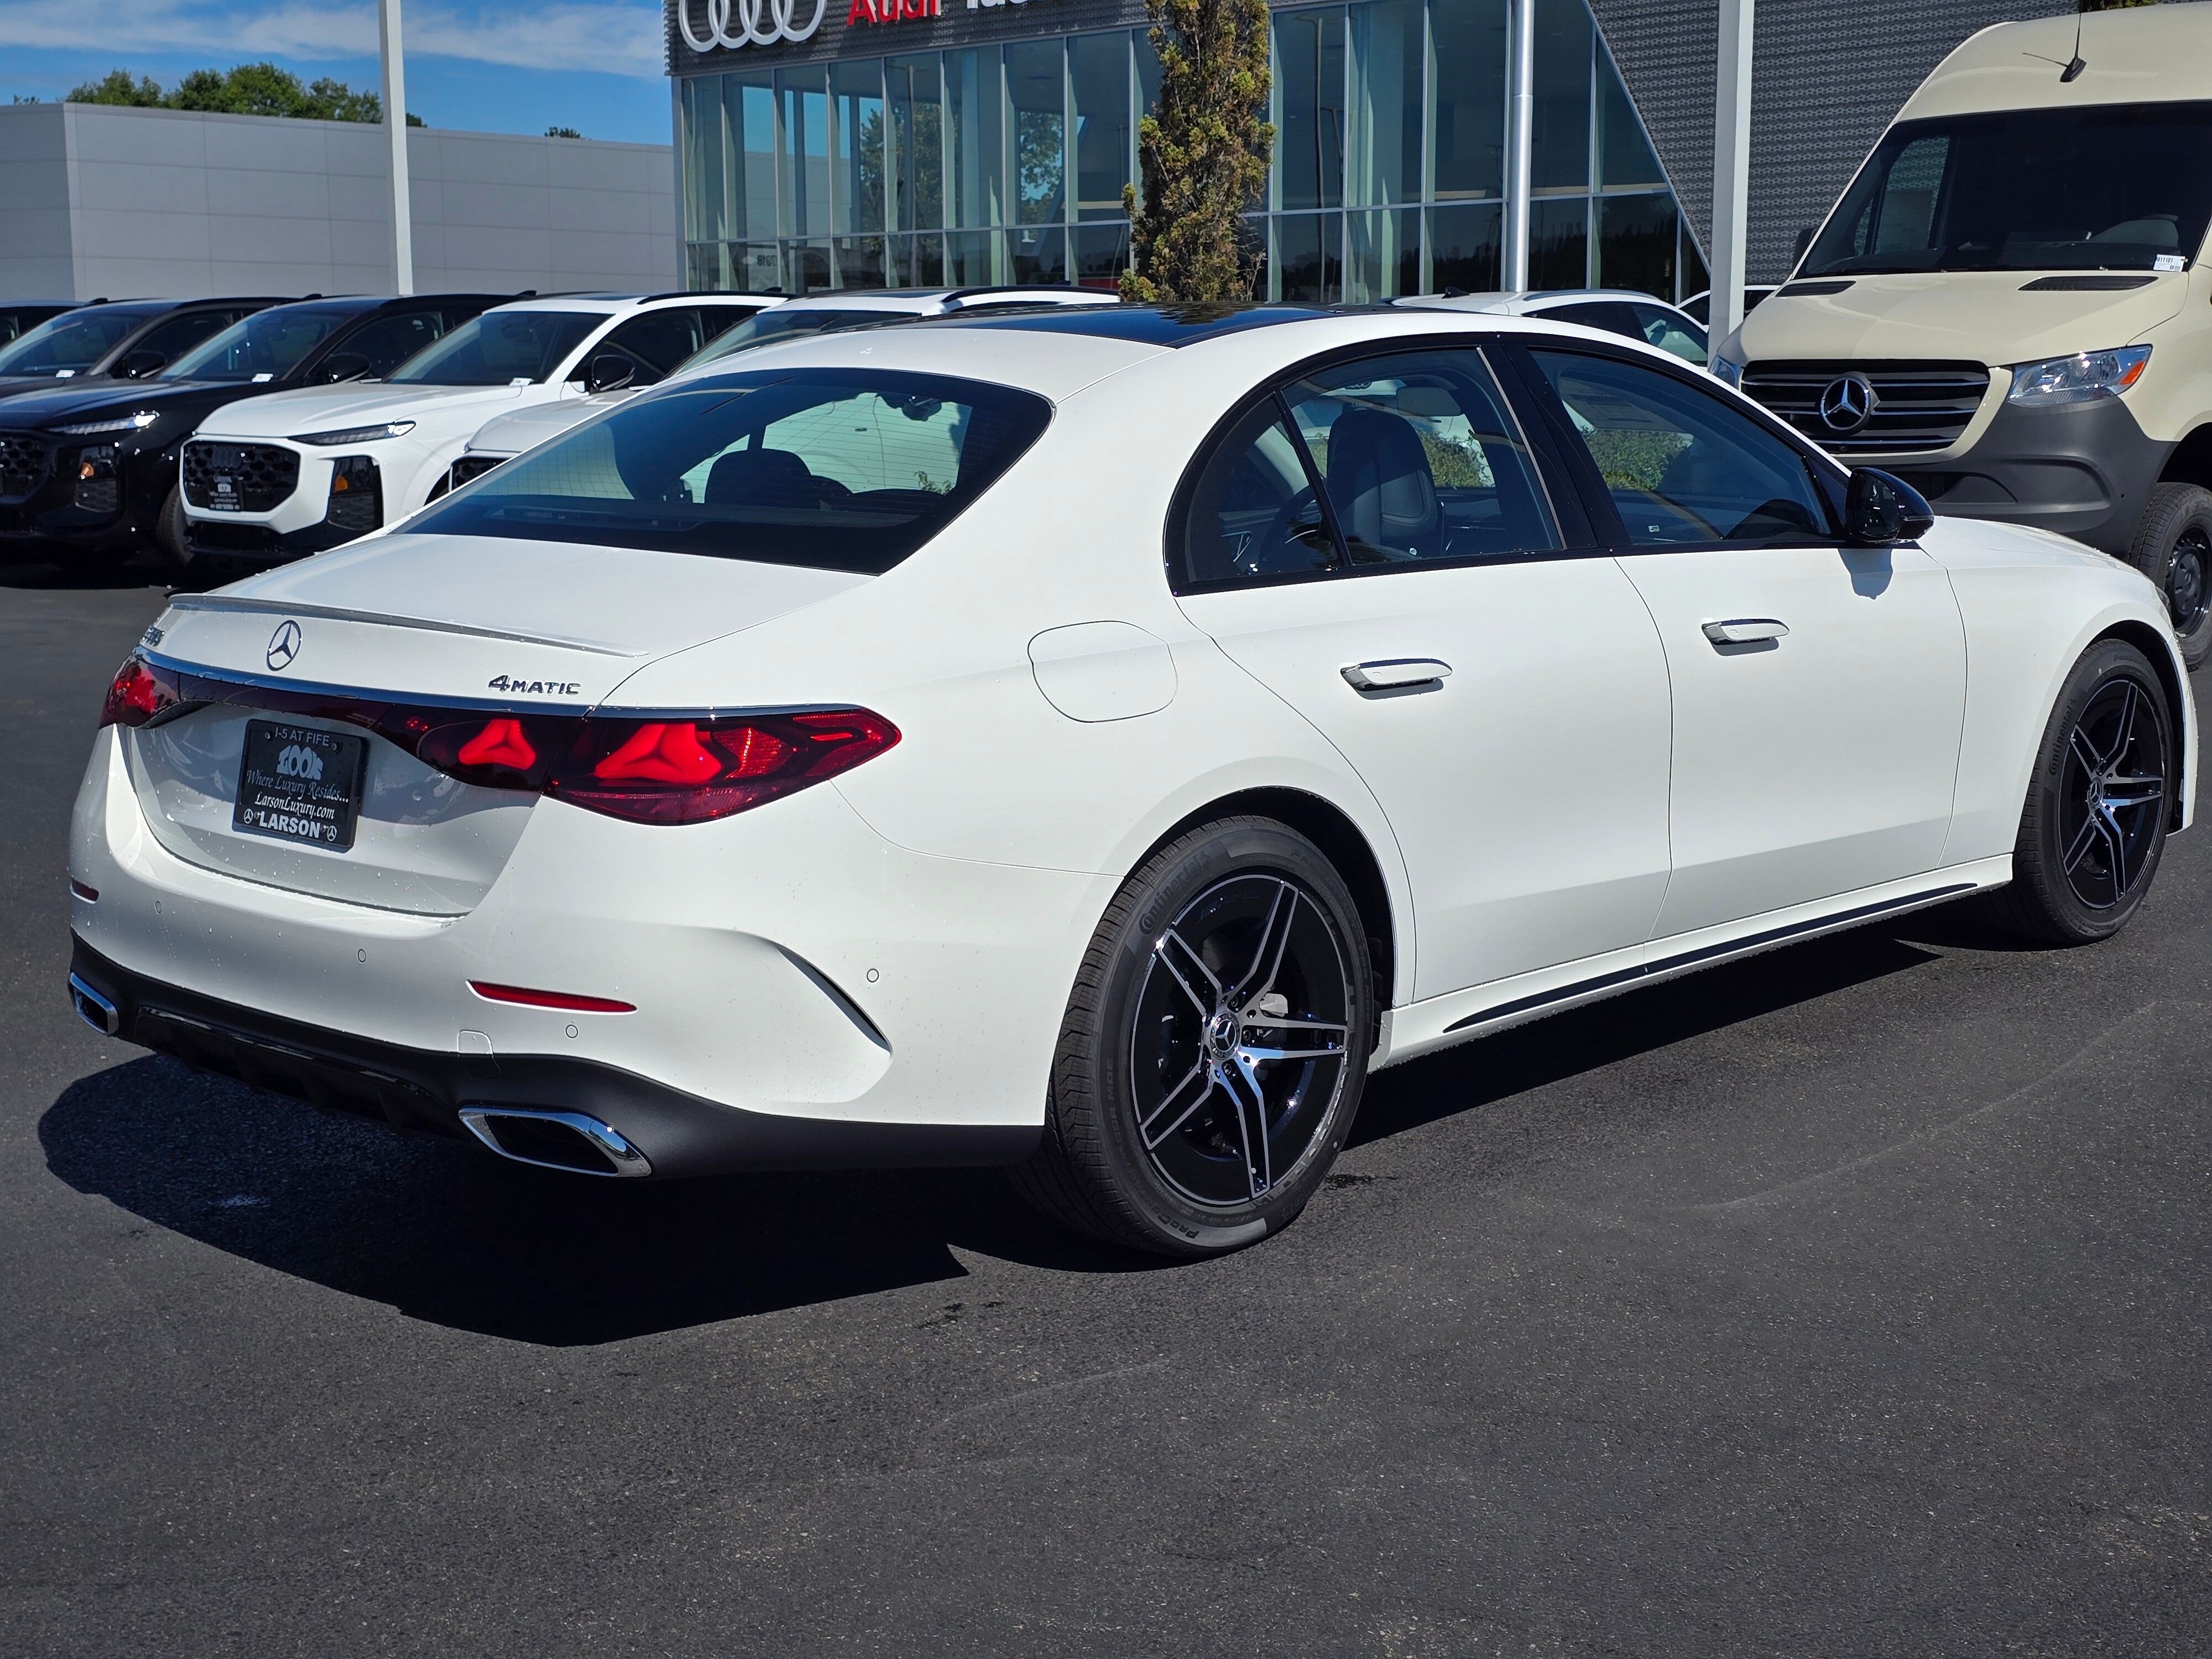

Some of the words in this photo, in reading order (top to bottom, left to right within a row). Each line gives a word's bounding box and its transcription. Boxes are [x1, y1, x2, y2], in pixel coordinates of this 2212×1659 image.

[488, 675, 581, 695] 4MATIC
[275, 727, 288, 739] I-5
[289, 729, 304, 742] AT
[306, 732, 330, 747] FIFE
[246, 769, 273, 788] Where
[274, 775, 306, 800] Luxury
[307, 781, 349, 803] Resides...
[254, 791, 335, 820] LarsonLuxury.com
[259, 811, 321, 838] LARSON
[1138, 856, 1204, 935] Continental
